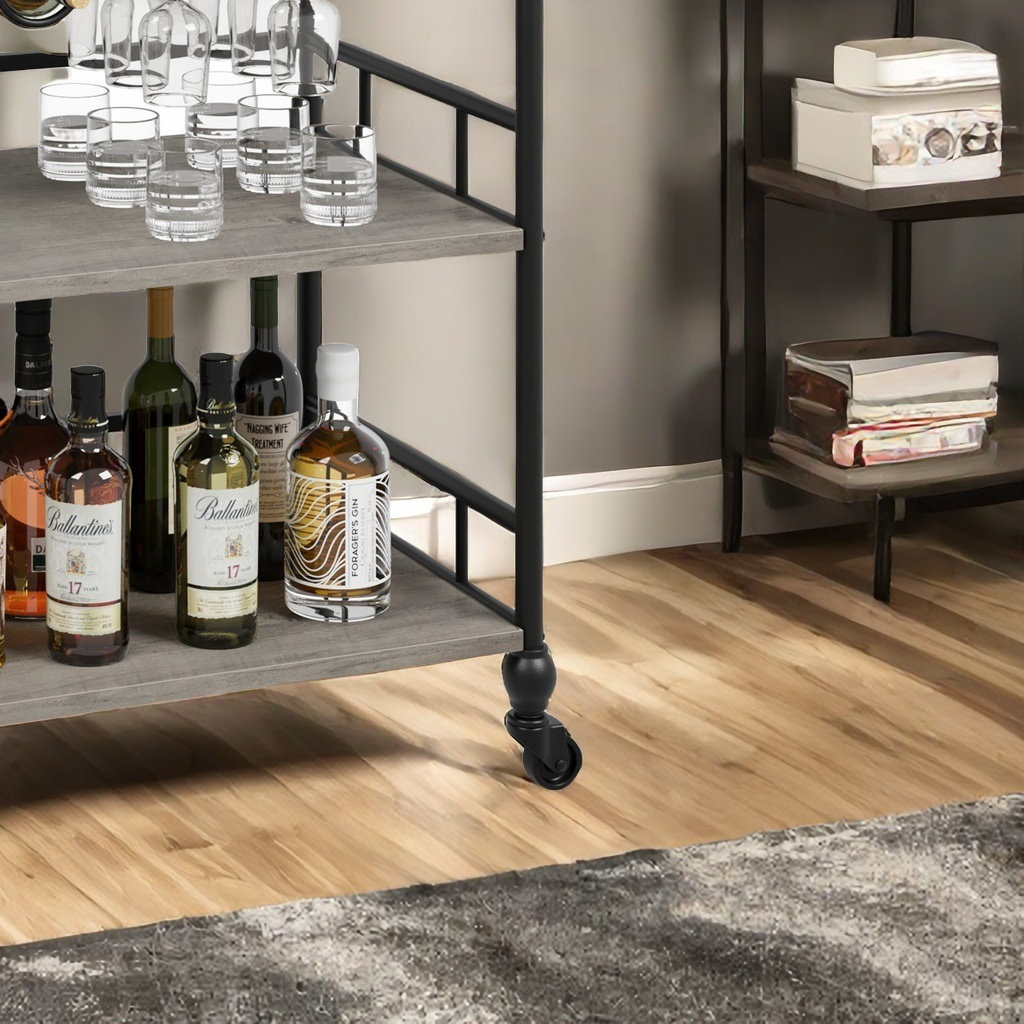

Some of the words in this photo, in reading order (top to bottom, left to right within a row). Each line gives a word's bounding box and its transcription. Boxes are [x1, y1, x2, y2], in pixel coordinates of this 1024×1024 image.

[251, 437, 284, 450] TREATMENT
[351, 498, 359, 517] GIN
[351, 520, 359, 577] FORAGER'S
[227, 564, 241, 579] 17
[68, 581, 83, 595] 17
